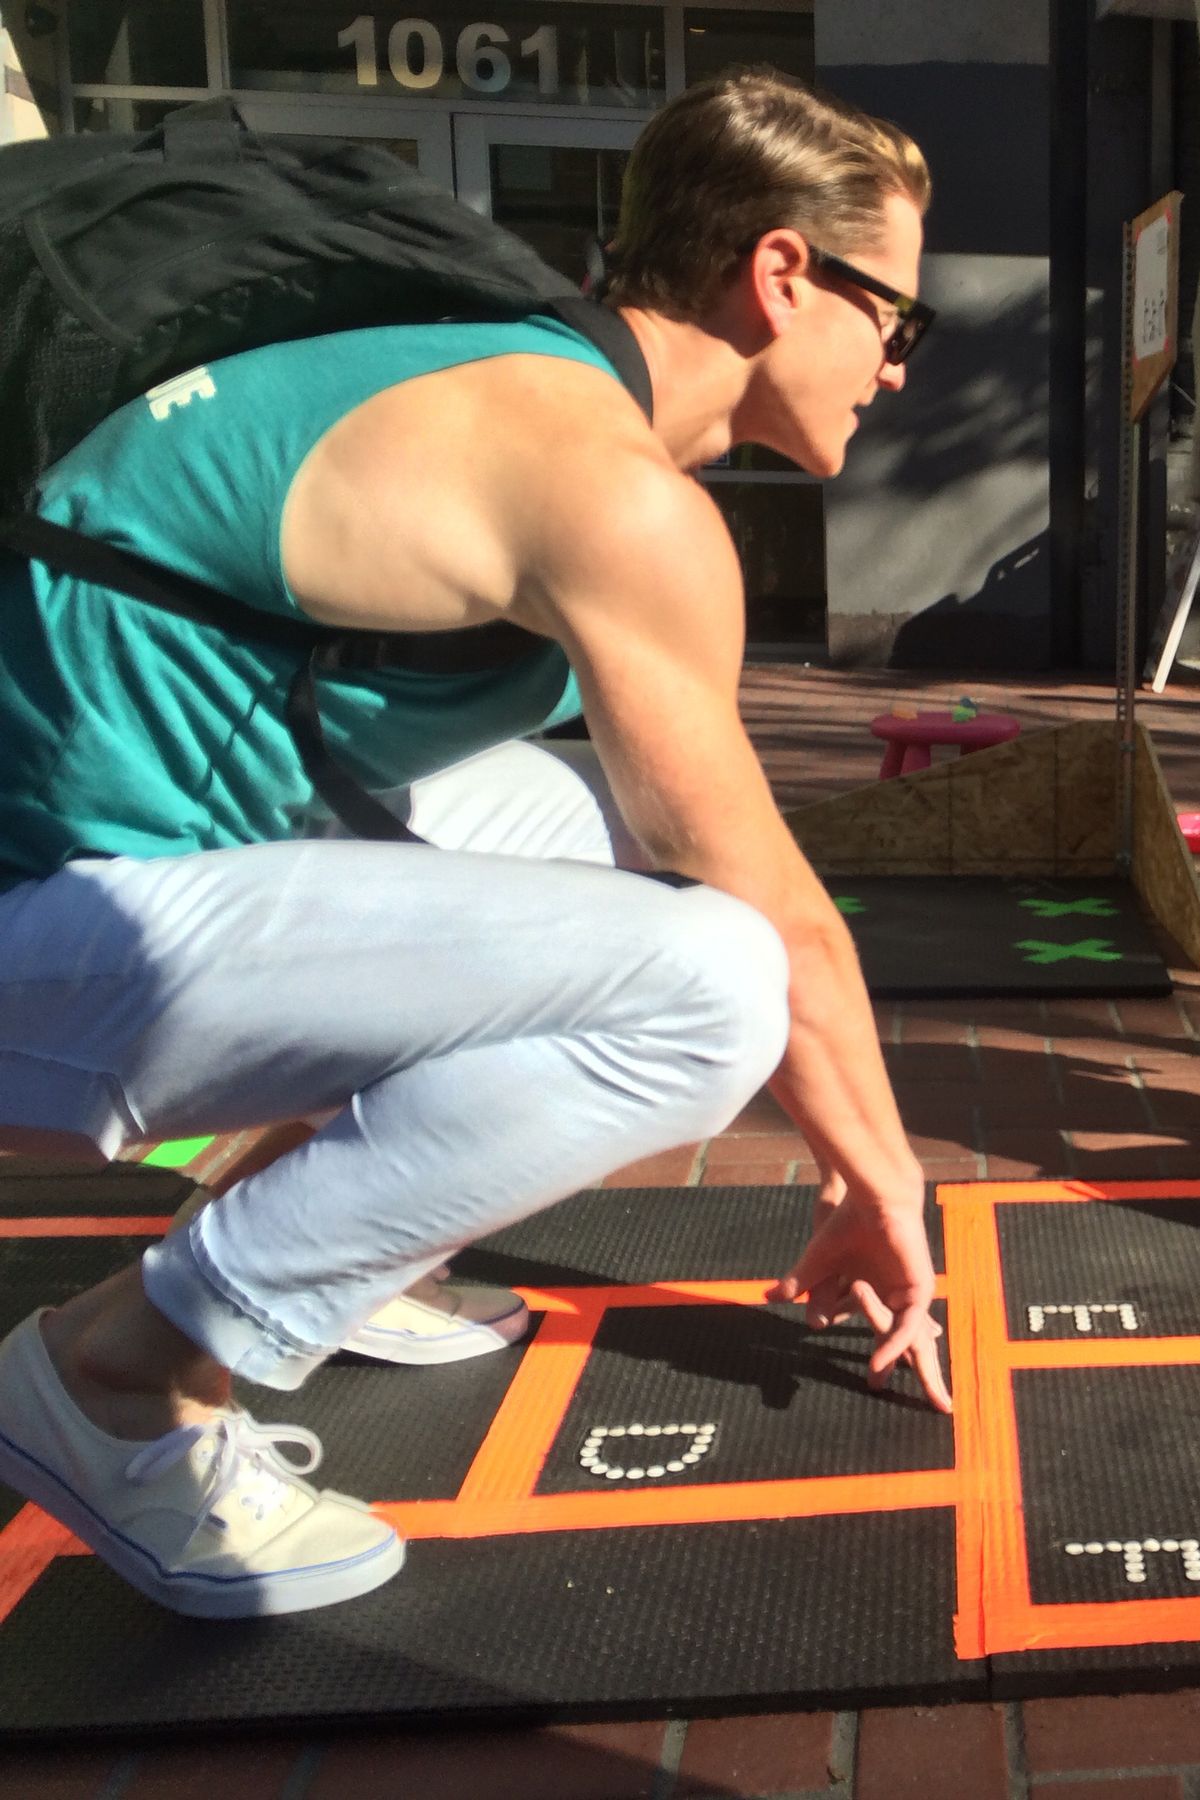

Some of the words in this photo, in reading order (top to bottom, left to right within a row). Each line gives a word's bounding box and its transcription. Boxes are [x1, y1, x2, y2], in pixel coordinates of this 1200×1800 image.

[337, 15, 558, 94] 1061
[1027, 1302, 1139, 1333] E
[578, 1422, 717, 1480] D
